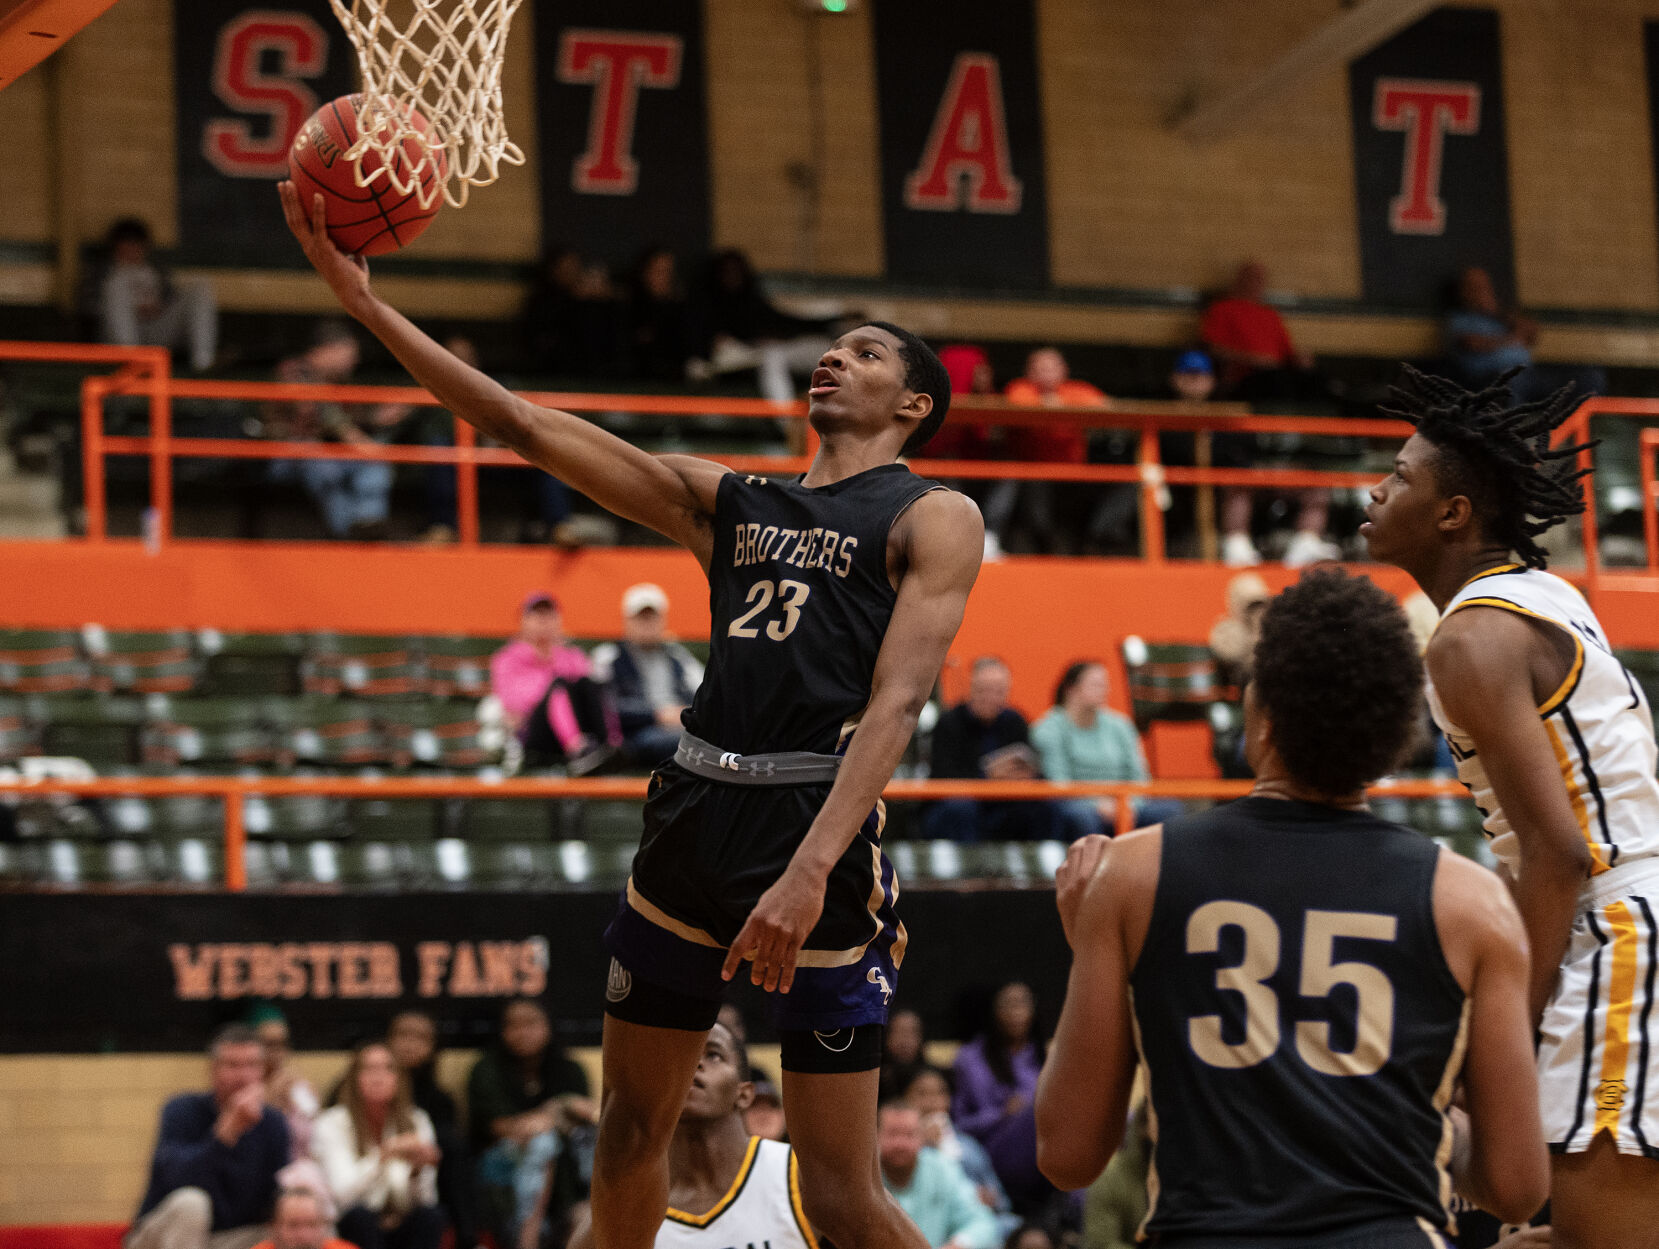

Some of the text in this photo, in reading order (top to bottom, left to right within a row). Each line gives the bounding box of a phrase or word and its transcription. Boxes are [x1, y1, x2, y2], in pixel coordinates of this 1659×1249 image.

[203, 10, 1481, 235] S T A T
[733, 522, 859, 579] BROTHERS
[727, 578, 811, 642] 23
[169, 939, 548, 998] WEBSTER FANS
[1185, 899, 1398, 1077] 35
